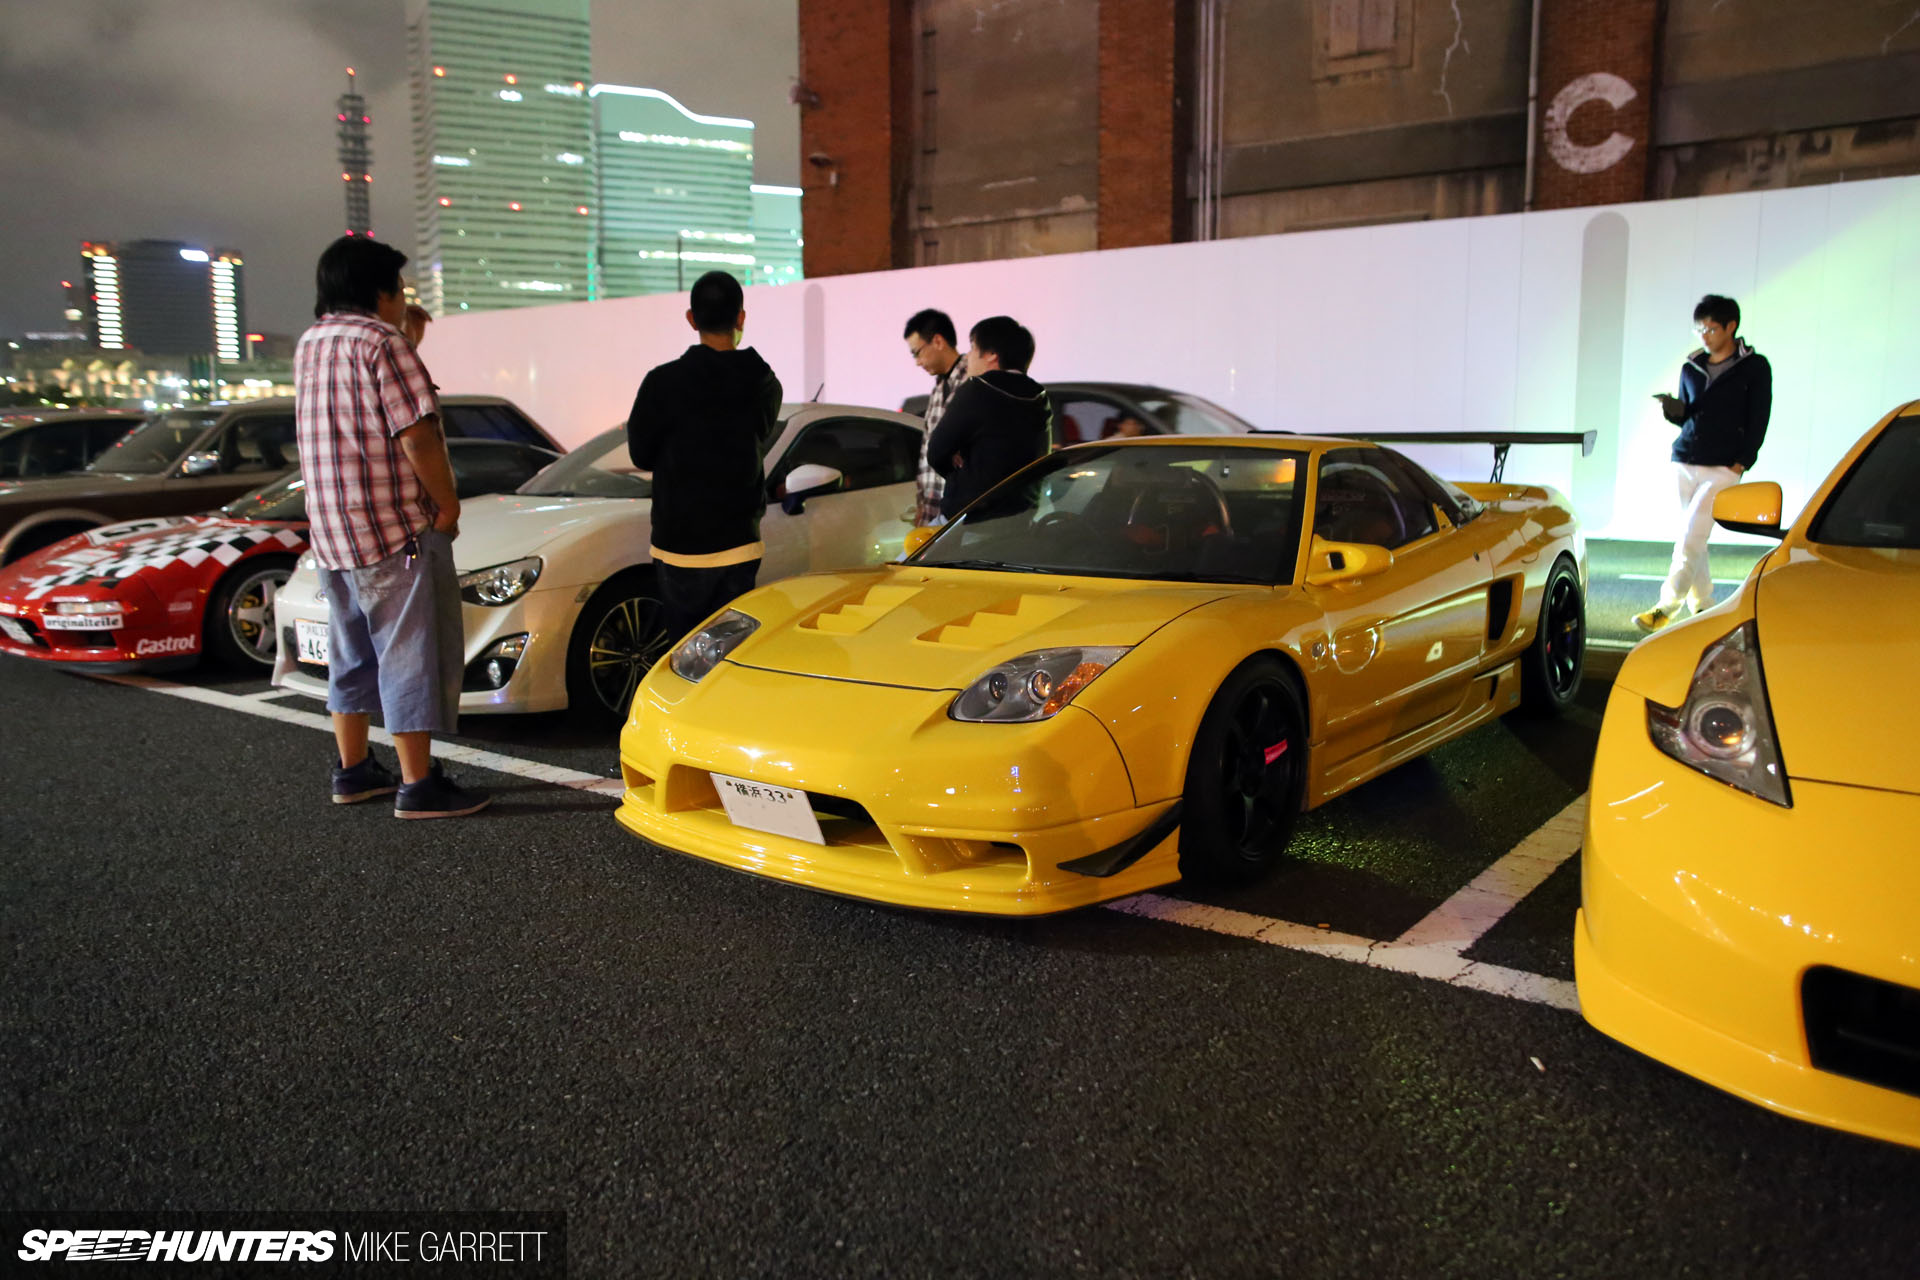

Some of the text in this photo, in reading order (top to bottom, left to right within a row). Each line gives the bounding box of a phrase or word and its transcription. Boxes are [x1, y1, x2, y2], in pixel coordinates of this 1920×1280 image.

[1544, 72, 1638, 174] C
[46, 615, 120, 629] originalteile
[137, 634, 195, 654] Castrol
[735, 783, 787, 804] 横浜 33
